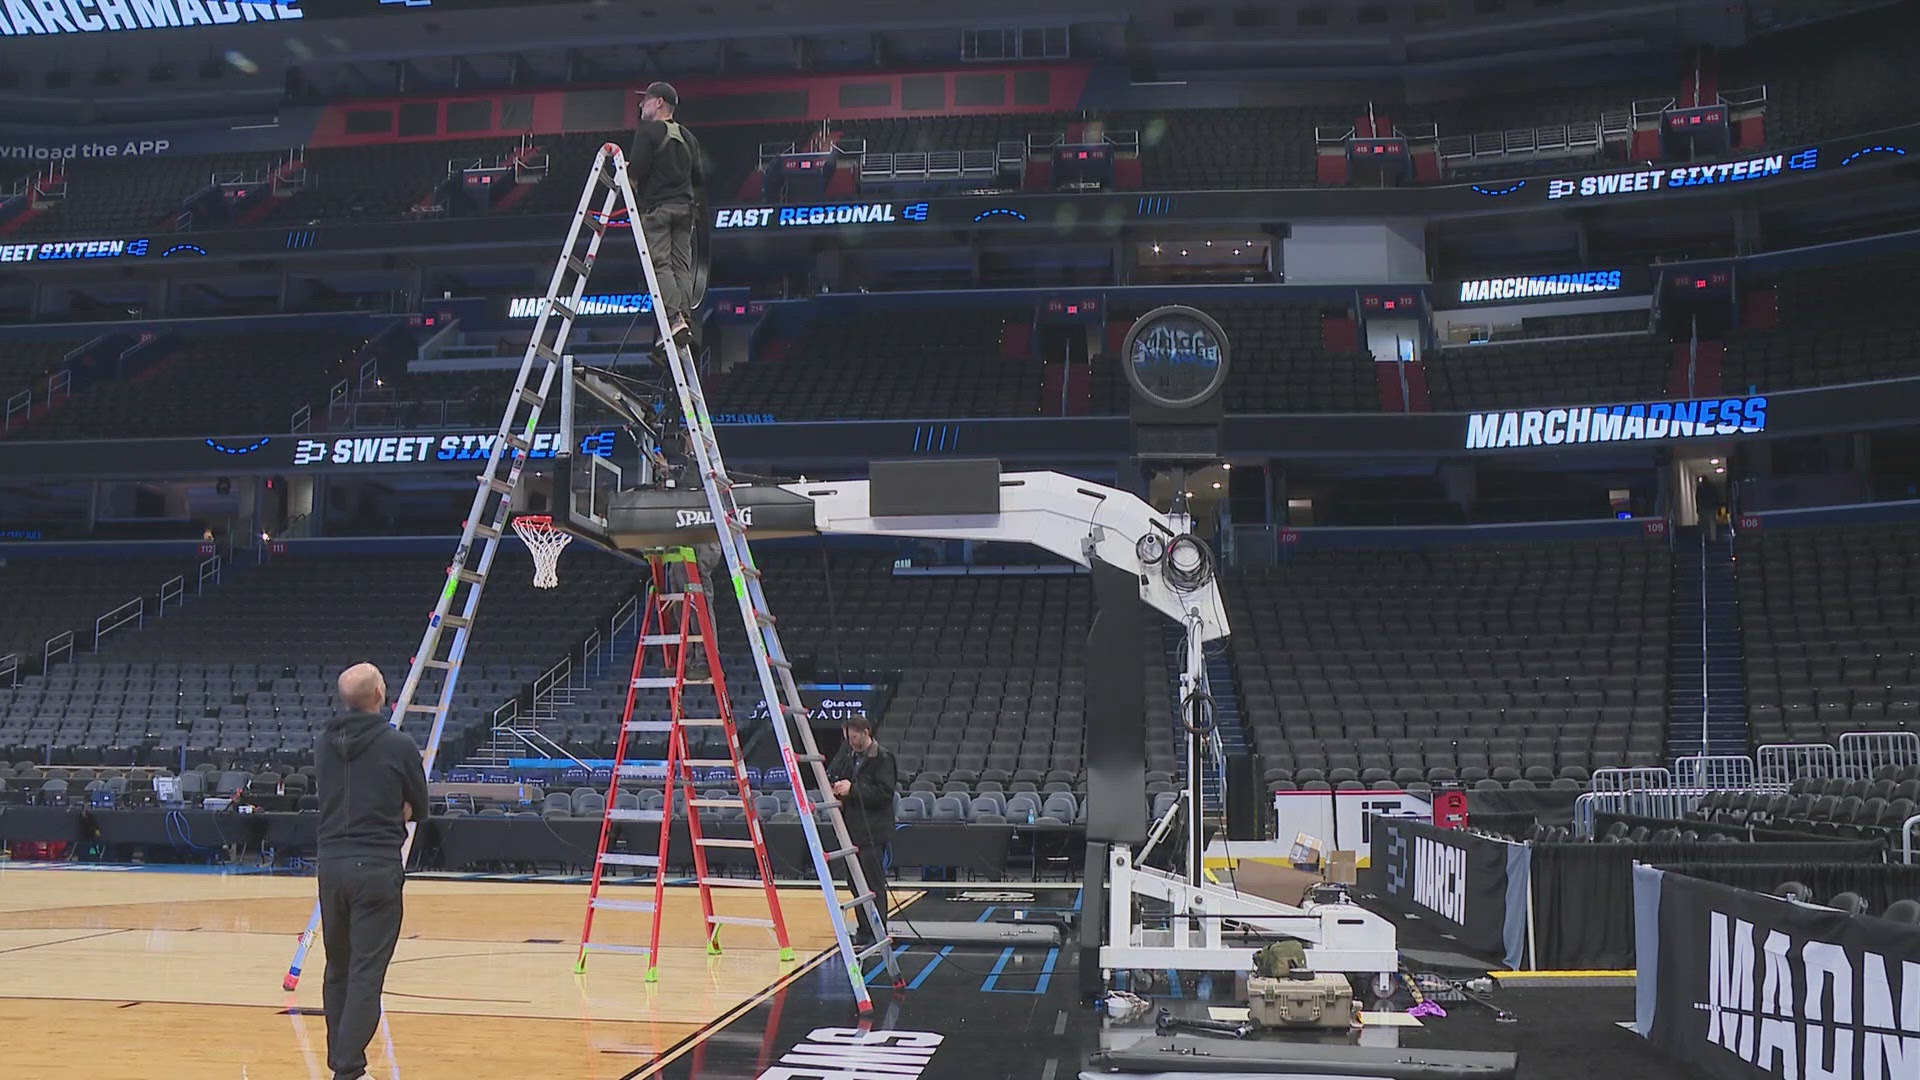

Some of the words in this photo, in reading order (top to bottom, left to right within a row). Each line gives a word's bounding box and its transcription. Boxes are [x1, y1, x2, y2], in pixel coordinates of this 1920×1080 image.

[82, 143, 118, 157] the
[122, 140, 171, 156] APP
[1580, 170, 1666, 196] SWEET
[1668, 154, 1784, 188] SIXTEEN
[715, 208, 774, 228] EAST
[779, 203, 895, 226] REGIONAL
[0, 243, 39, 262] EET
[38, 240, 125, 260] SIXTEEN
[1460, 270, 1622, 302] MARCHMADNESS
[1465, 396, 1767, 449] MARCHMADNESS
[331, 436, 435, 464] SWEET
[436, 432, 565, 461] SIXE
[675, 506, 754, 528] SPALG
[1646, 523, 1664, 532] 109
[1741, 519, 1758, 528] 108
[201, 545, 214, 553] 112
[1414, 835, 1467, 926] MARCH
